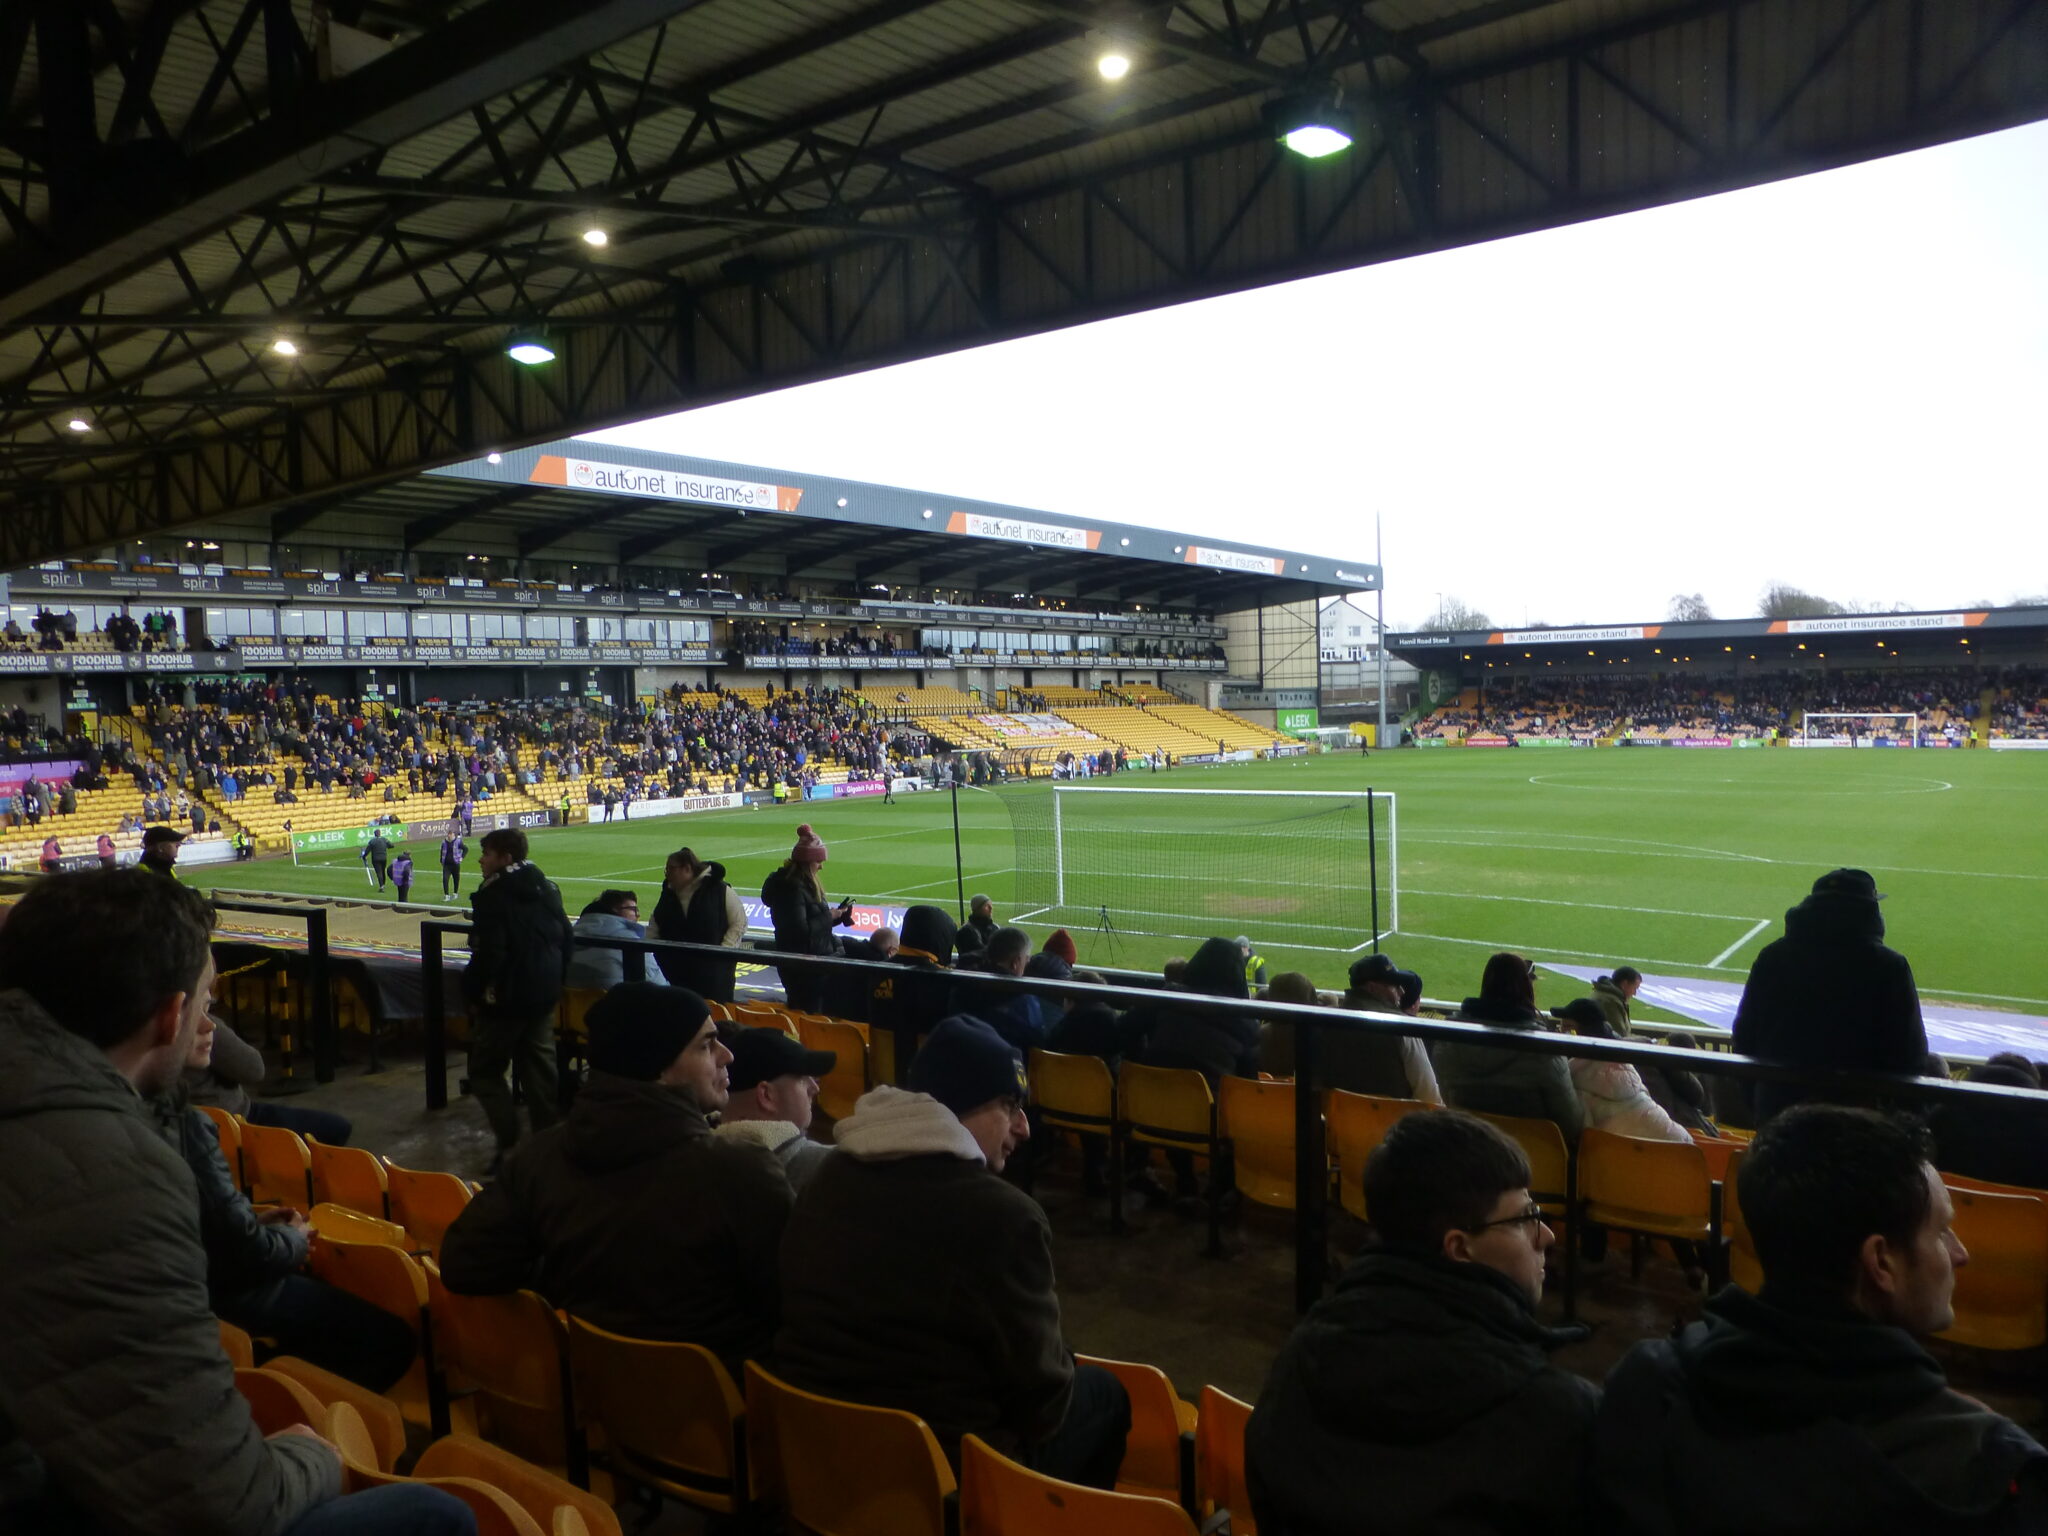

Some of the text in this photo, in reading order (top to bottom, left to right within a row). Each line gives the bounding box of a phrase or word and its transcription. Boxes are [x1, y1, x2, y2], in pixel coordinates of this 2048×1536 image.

[595, 469, 754, 504] autonet insurance
[982, 521, 1022, 540] autonet
[42, 572, 83, 588] spirl
[183, 577, 220, 591] spirl
[307, 582, 340, 596] spirl
[417, 586, 446, 599] spirl
[514, 590, 540, 602] spirl
[601, 594, 624, 606] spirl
[679, 597, 700, 609] spirl
[1806, 616, 1943, 631] autonet insurance stand
[1432, 636, 1450, 645] Stand
[1518, 629, 1627, 643] autonet insurance stand
[241, 646, 283, 656] FOODHUB
[303, 646, 342, 656] FOODHUB
[361, 646, 398, 656] FOODHUB
[415, 646, 450, 656] FOODHUB
[467, 647, 499, 656] FOODHUB
[0, 655, 47, 666] OODHUB
[72, 655, 123, 666] FOODHUB
[146, 654, 193, 664] FOODHUB
[1291, 714, 1310, 728] LEEK
[875, 783, 886, 791] Fibr
[684, 797, 721, 810] GUTTERPLUS
[318, 831, 345, 843] LEEK
